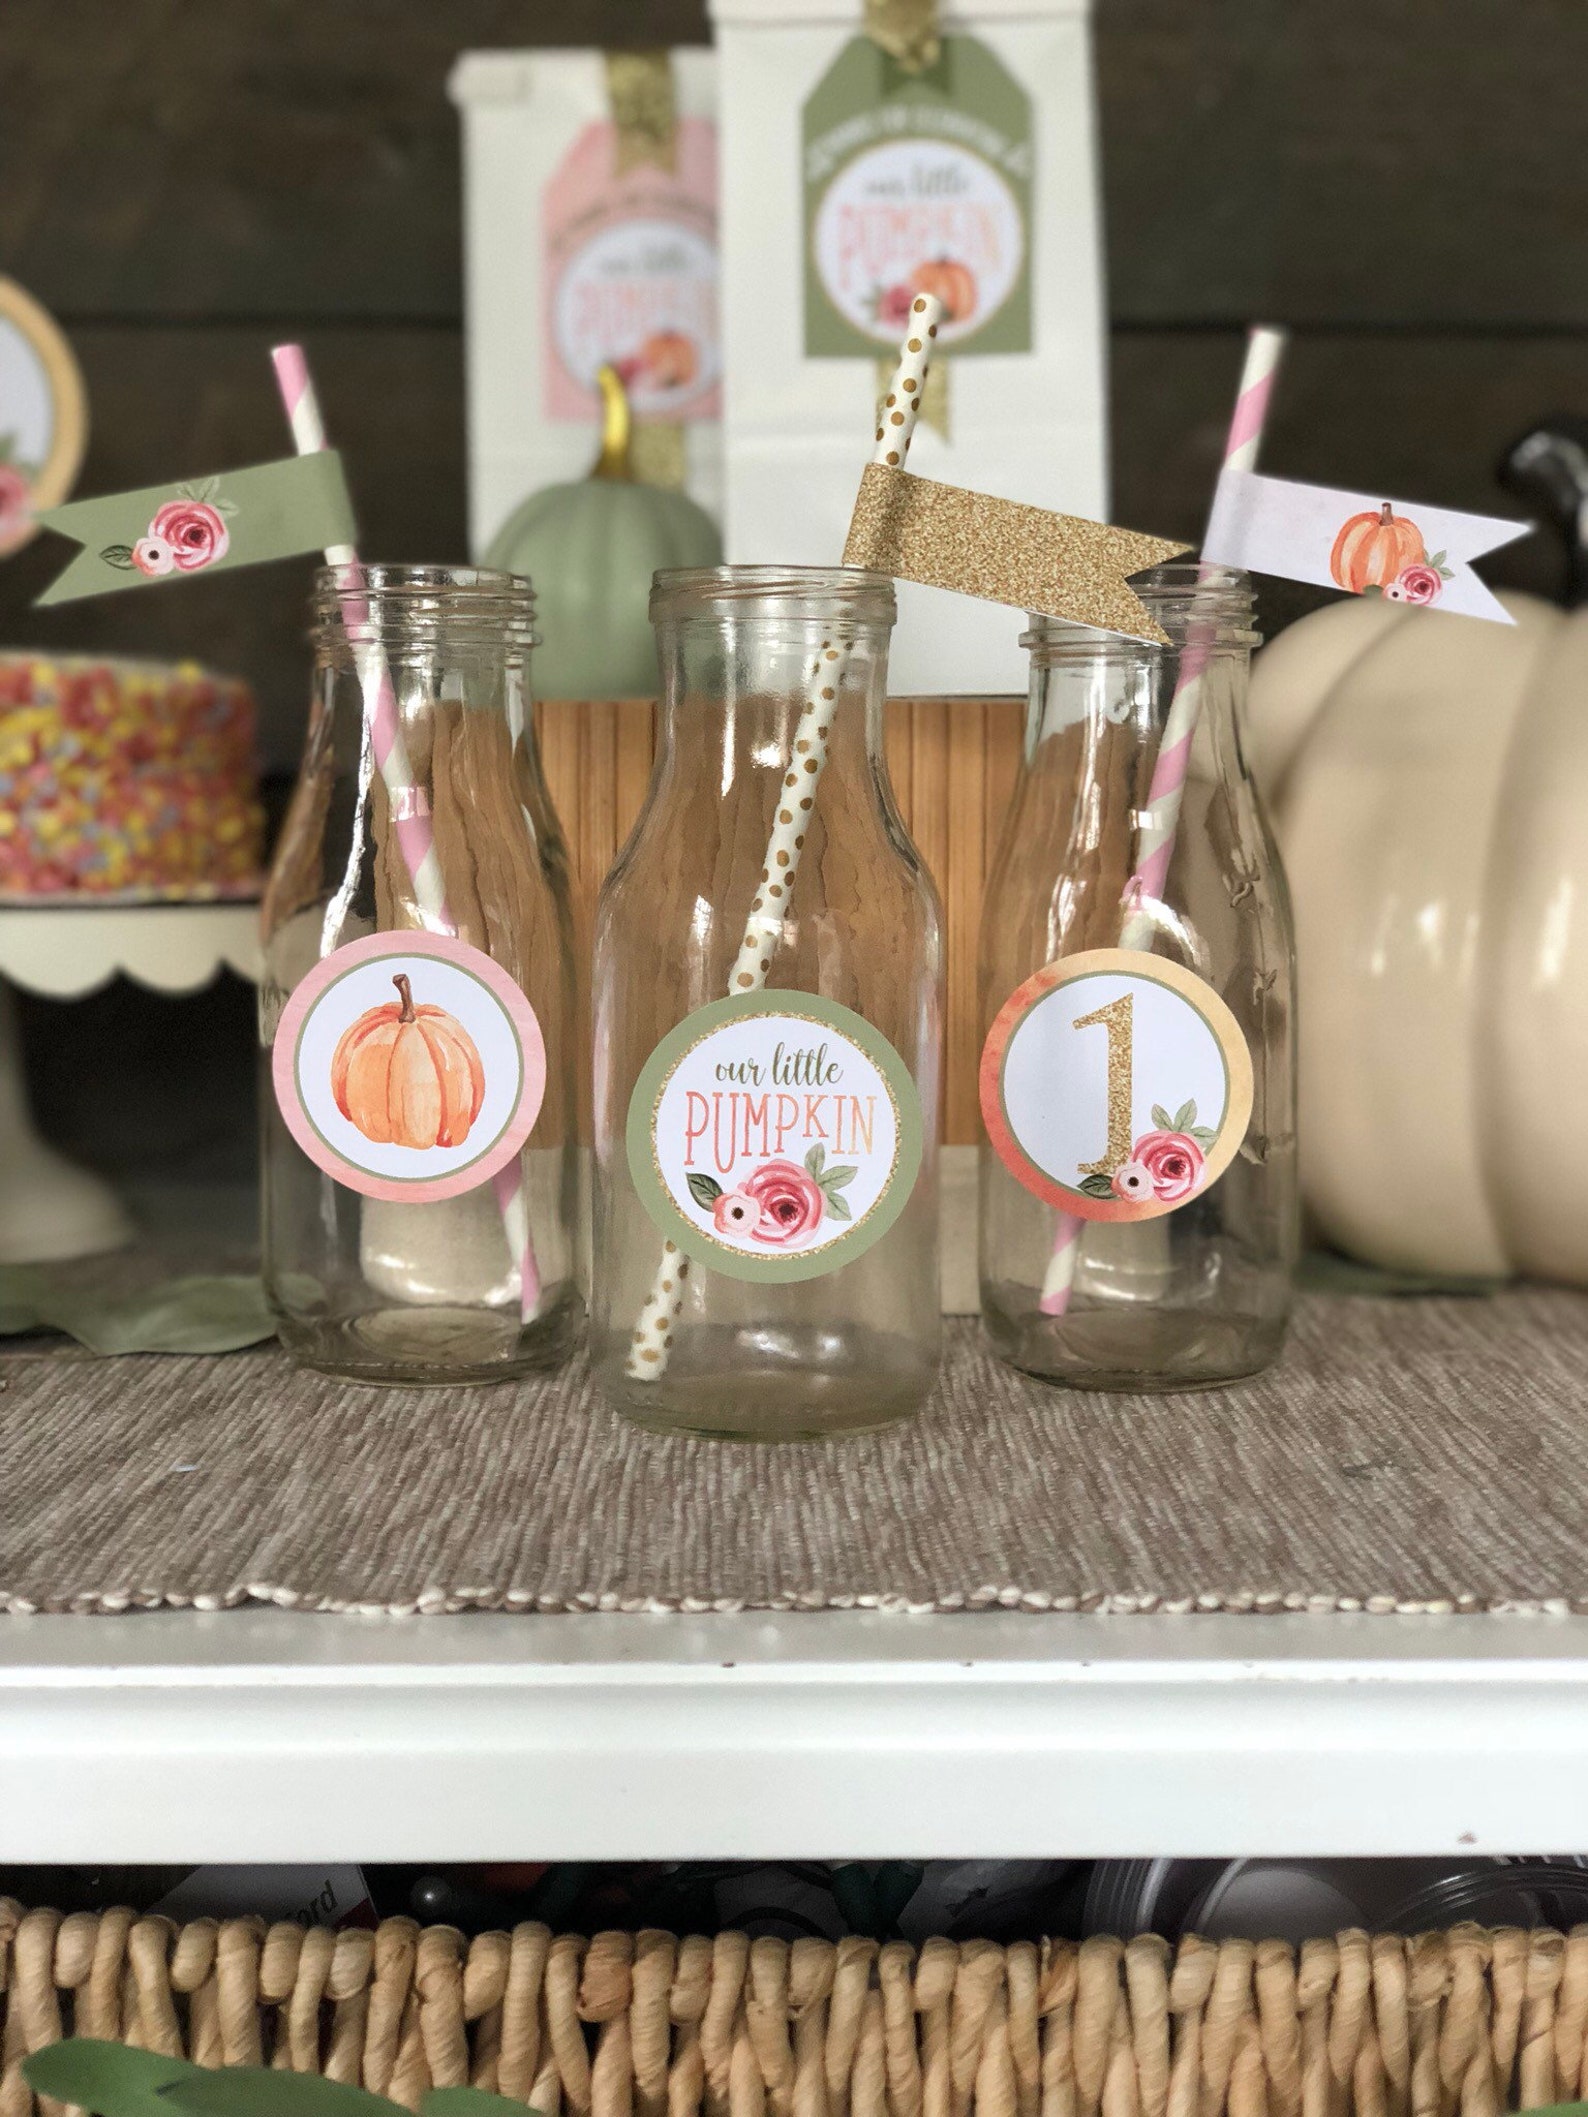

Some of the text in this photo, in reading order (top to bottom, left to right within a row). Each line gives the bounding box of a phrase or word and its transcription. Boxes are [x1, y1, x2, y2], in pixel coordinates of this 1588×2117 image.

[715, 1041, 843, 1086] our little
[1072, 992, 1134, 1175] 1
[684, 1091, 877, 1174] PUMPKIN
